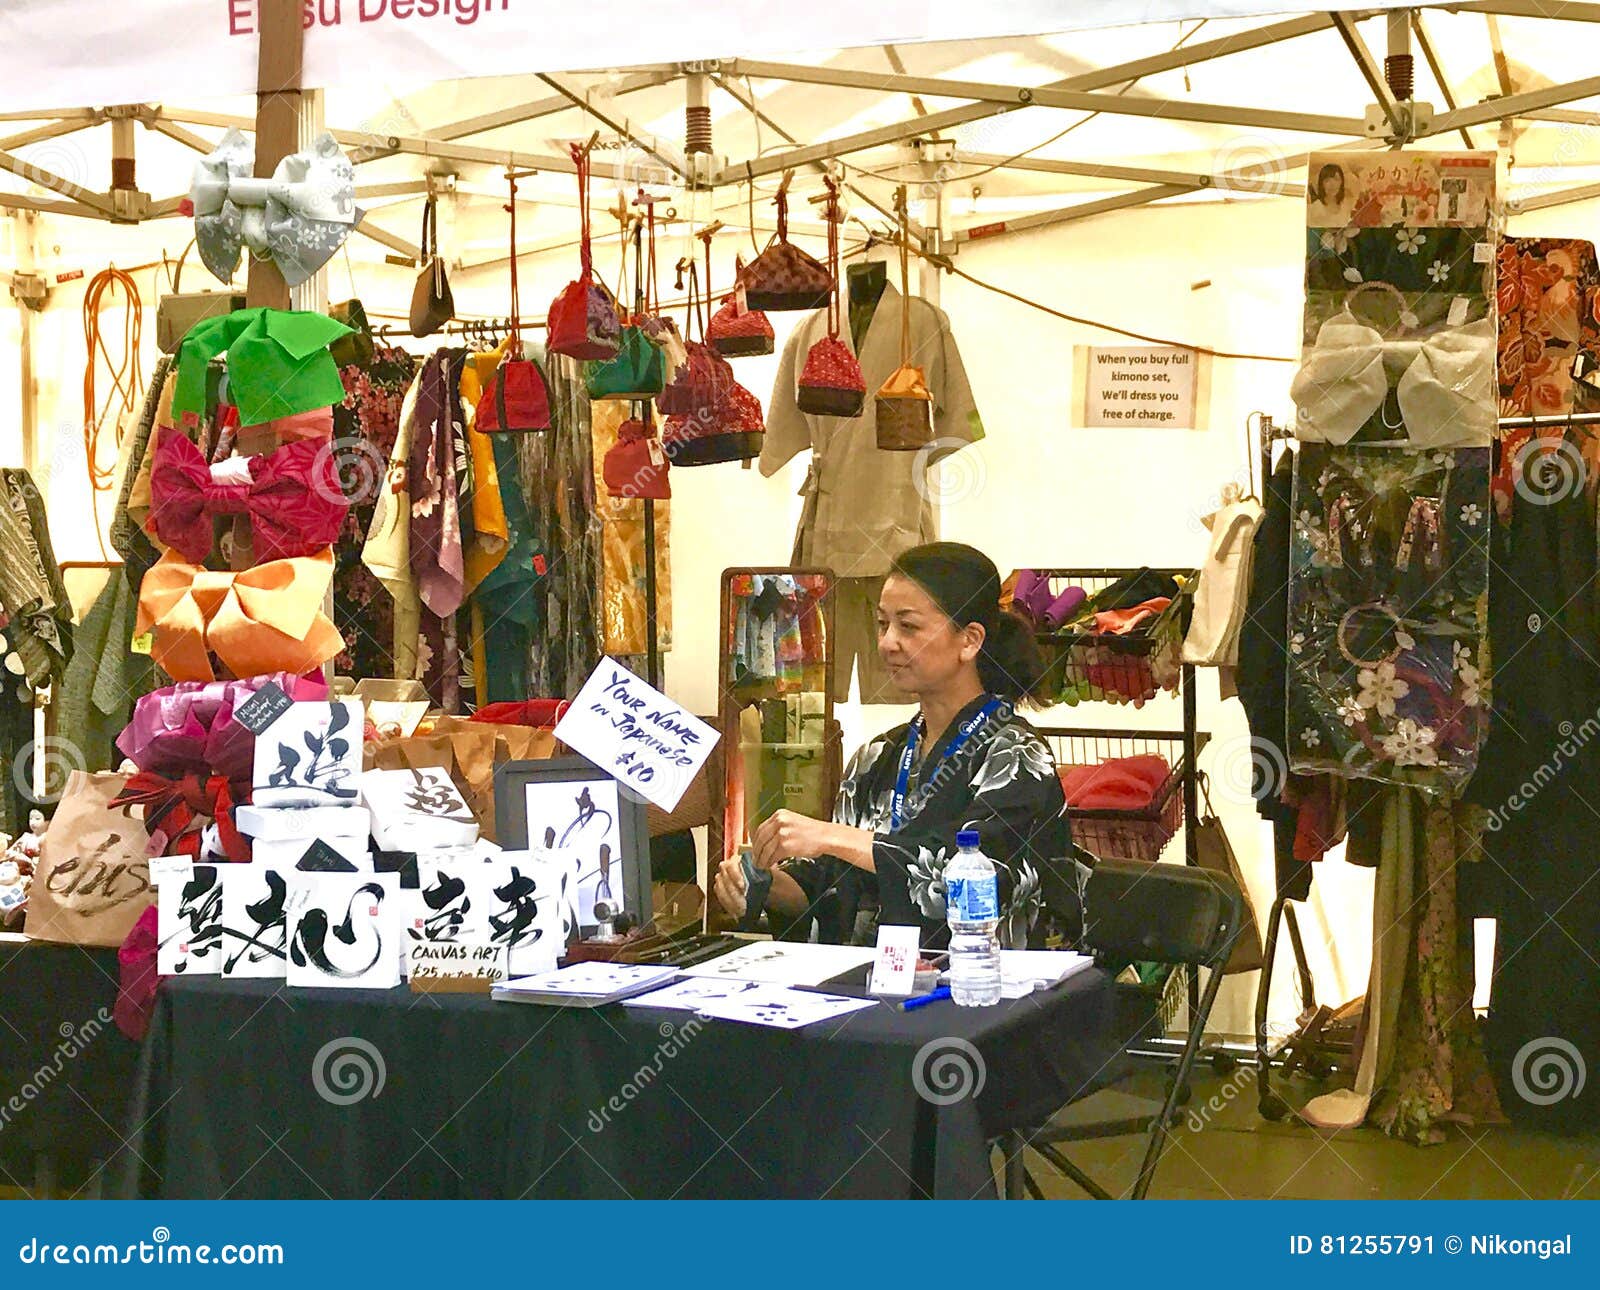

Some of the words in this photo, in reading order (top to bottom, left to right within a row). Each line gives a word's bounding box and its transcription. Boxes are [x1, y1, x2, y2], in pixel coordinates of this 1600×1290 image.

[1097, 354, 1126, 364] When
[1128, 356, 1147, 366] you
[1150, 354, 1169, 366] buy
[1171, 354, 1189, 364] full
[1111, 371, 1150, 381] kimono
[1152, 373, 1170, 383] set,
[1130, 390, 1157, 400] dress
[1159, 393, 1179, 402] you
[1103, 409, 1123, 419] free
[1125, 409, 1136, 419] of
[1138, 409, 1175, 421] charge.
[602, 671, 647, 712] YOUR
[611, 712, 693, 767] Japanese
[411, 944, 467, 960] CANVAS
[473, 946, 501, 962] ART
